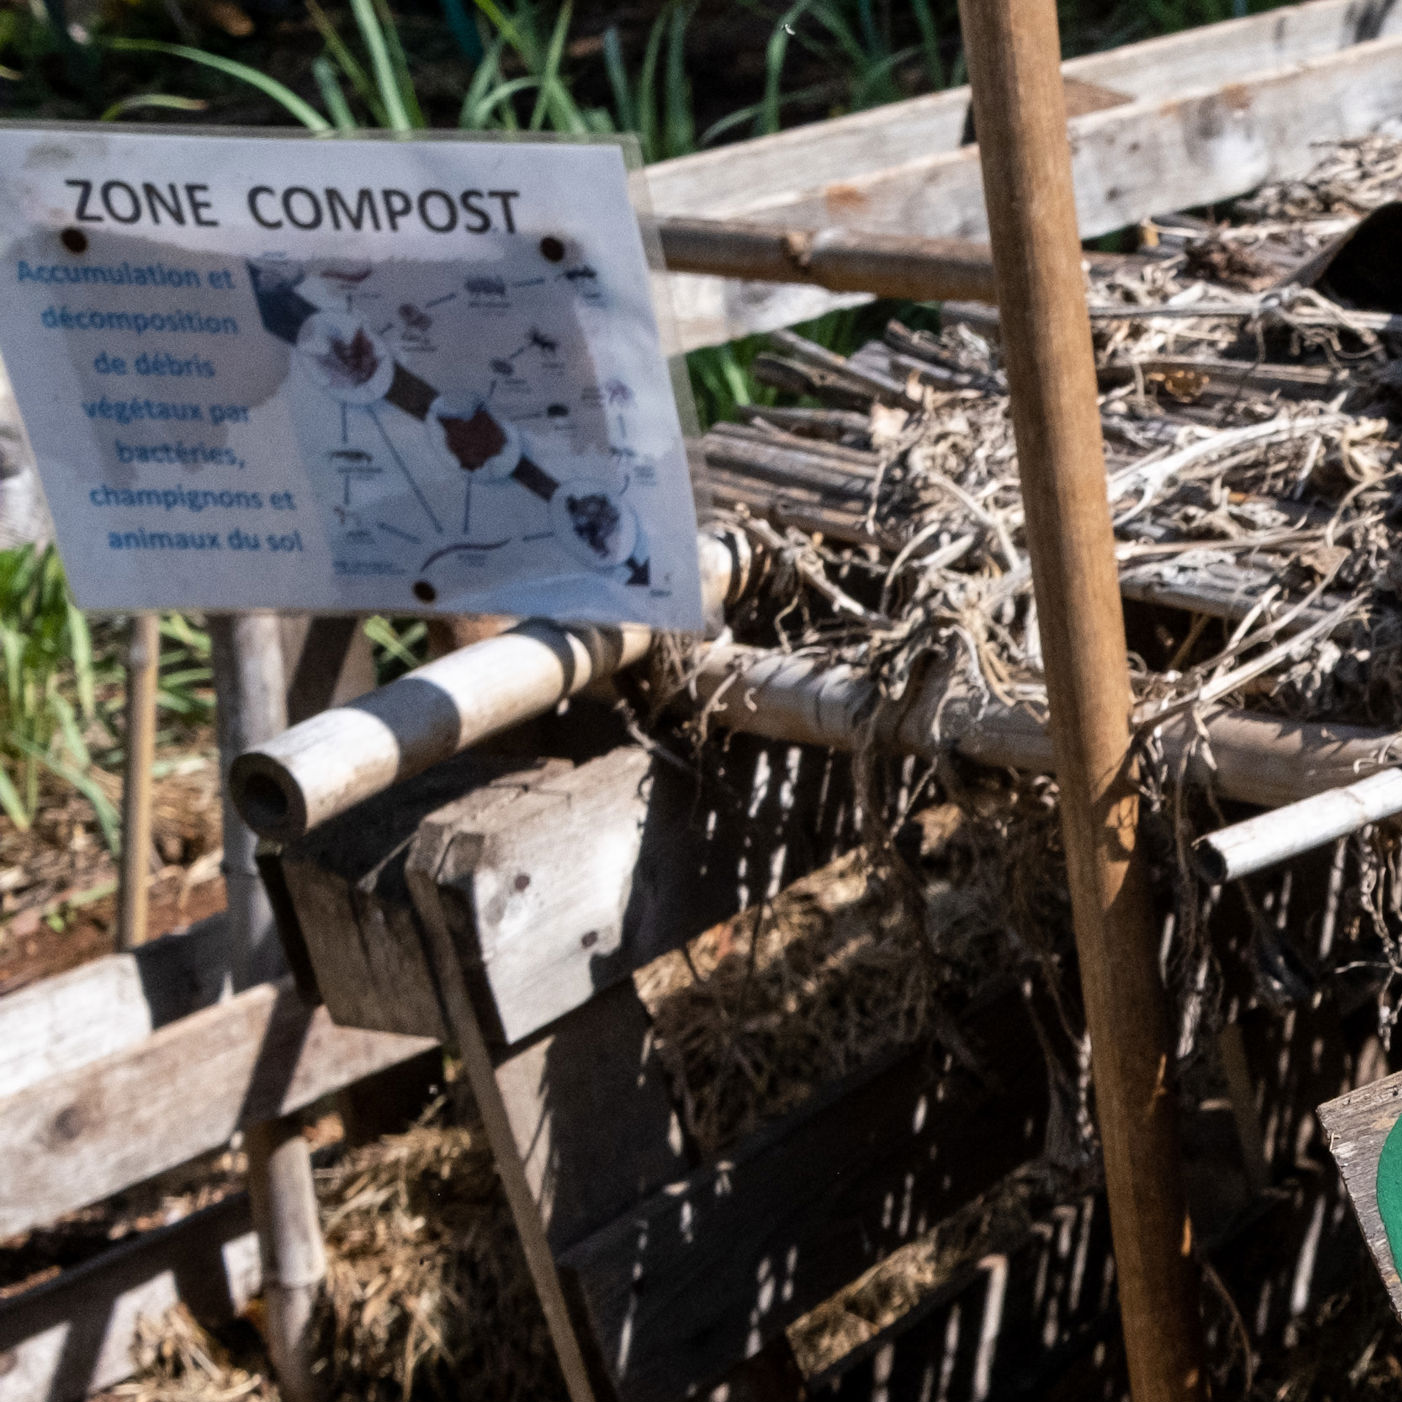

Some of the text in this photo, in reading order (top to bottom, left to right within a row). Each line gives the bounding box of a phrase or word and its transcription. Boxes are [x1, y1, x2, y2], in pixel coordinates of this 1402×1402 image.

[65, 179, 520, 234] ZONE COMPOST
[17, 260, 236, 289] Accumulation et
[41, 304, 238, 337] décomposition
[94, 351, 216, 378] de débris
[82, 397, 249, 426] végétaux par
[115, 439, 246, 470] bactéries,
[89, 484, 297, 512] champignons et
[108, 527, 303, 552] animaux du sol
